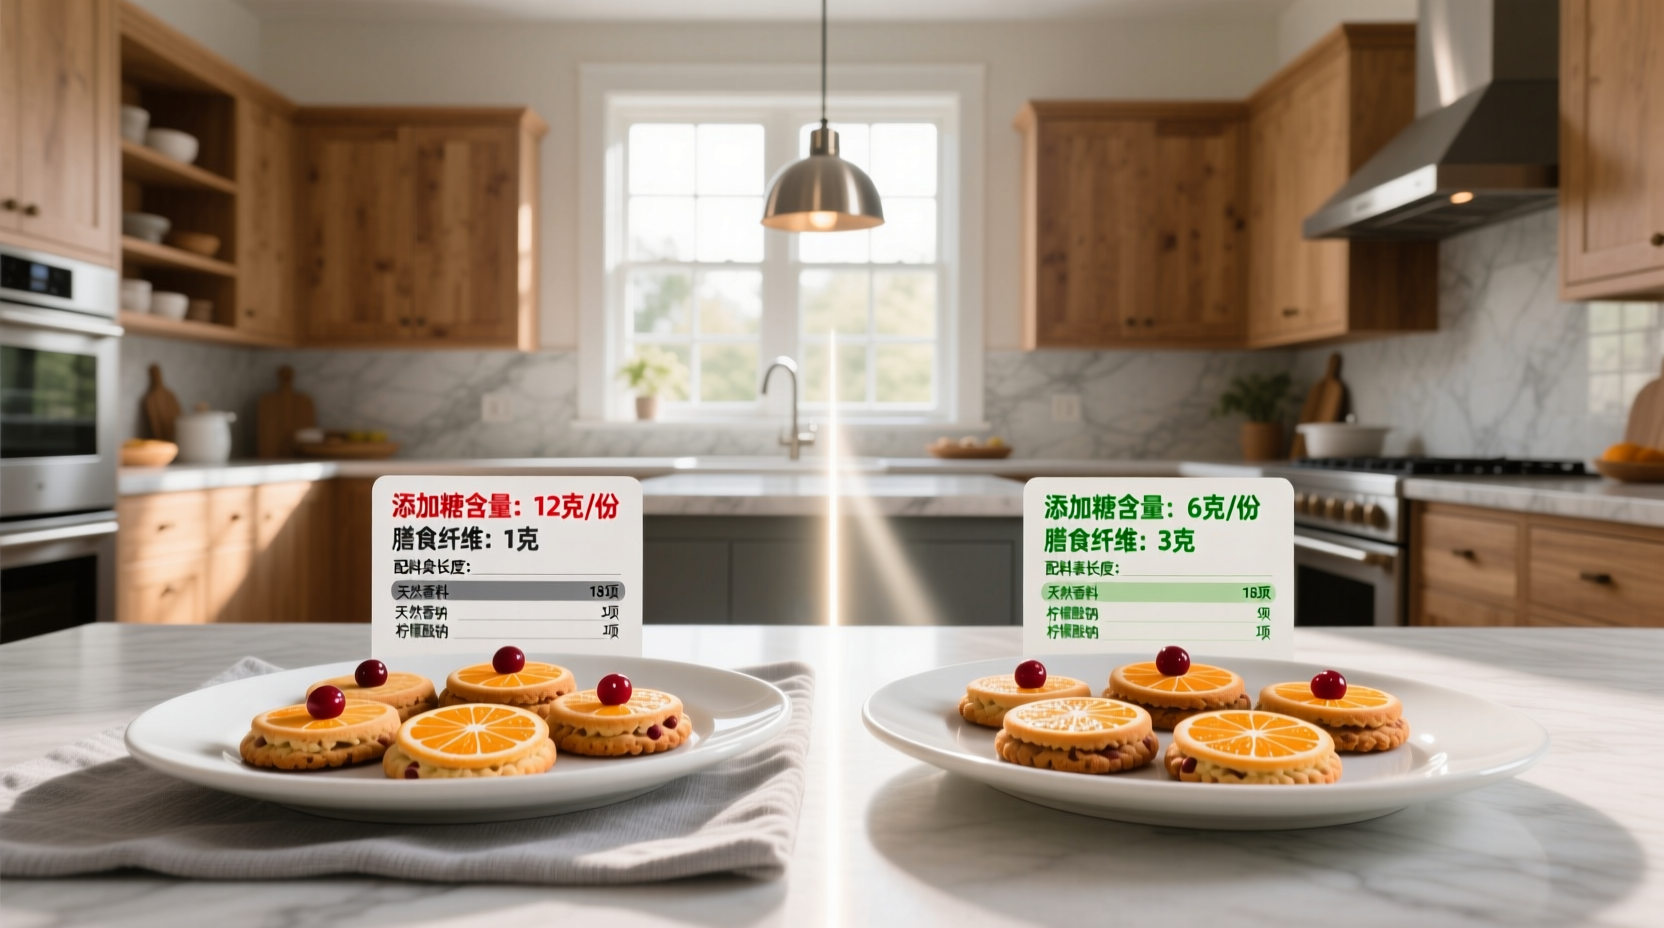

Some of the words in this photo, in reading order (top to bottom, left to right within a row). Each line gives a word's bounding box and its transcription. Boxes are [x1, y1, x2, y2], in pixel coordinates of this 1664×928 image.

[391, 493, 620, 520] 添加糖含量：12克/份
[1044, 494, 1260, 521] 添加糖含量：6克/份
[391, 526, 539, 551] 膳食纤维：1克
[1044, 526, 1195, 553] 膳食纤维：3克
